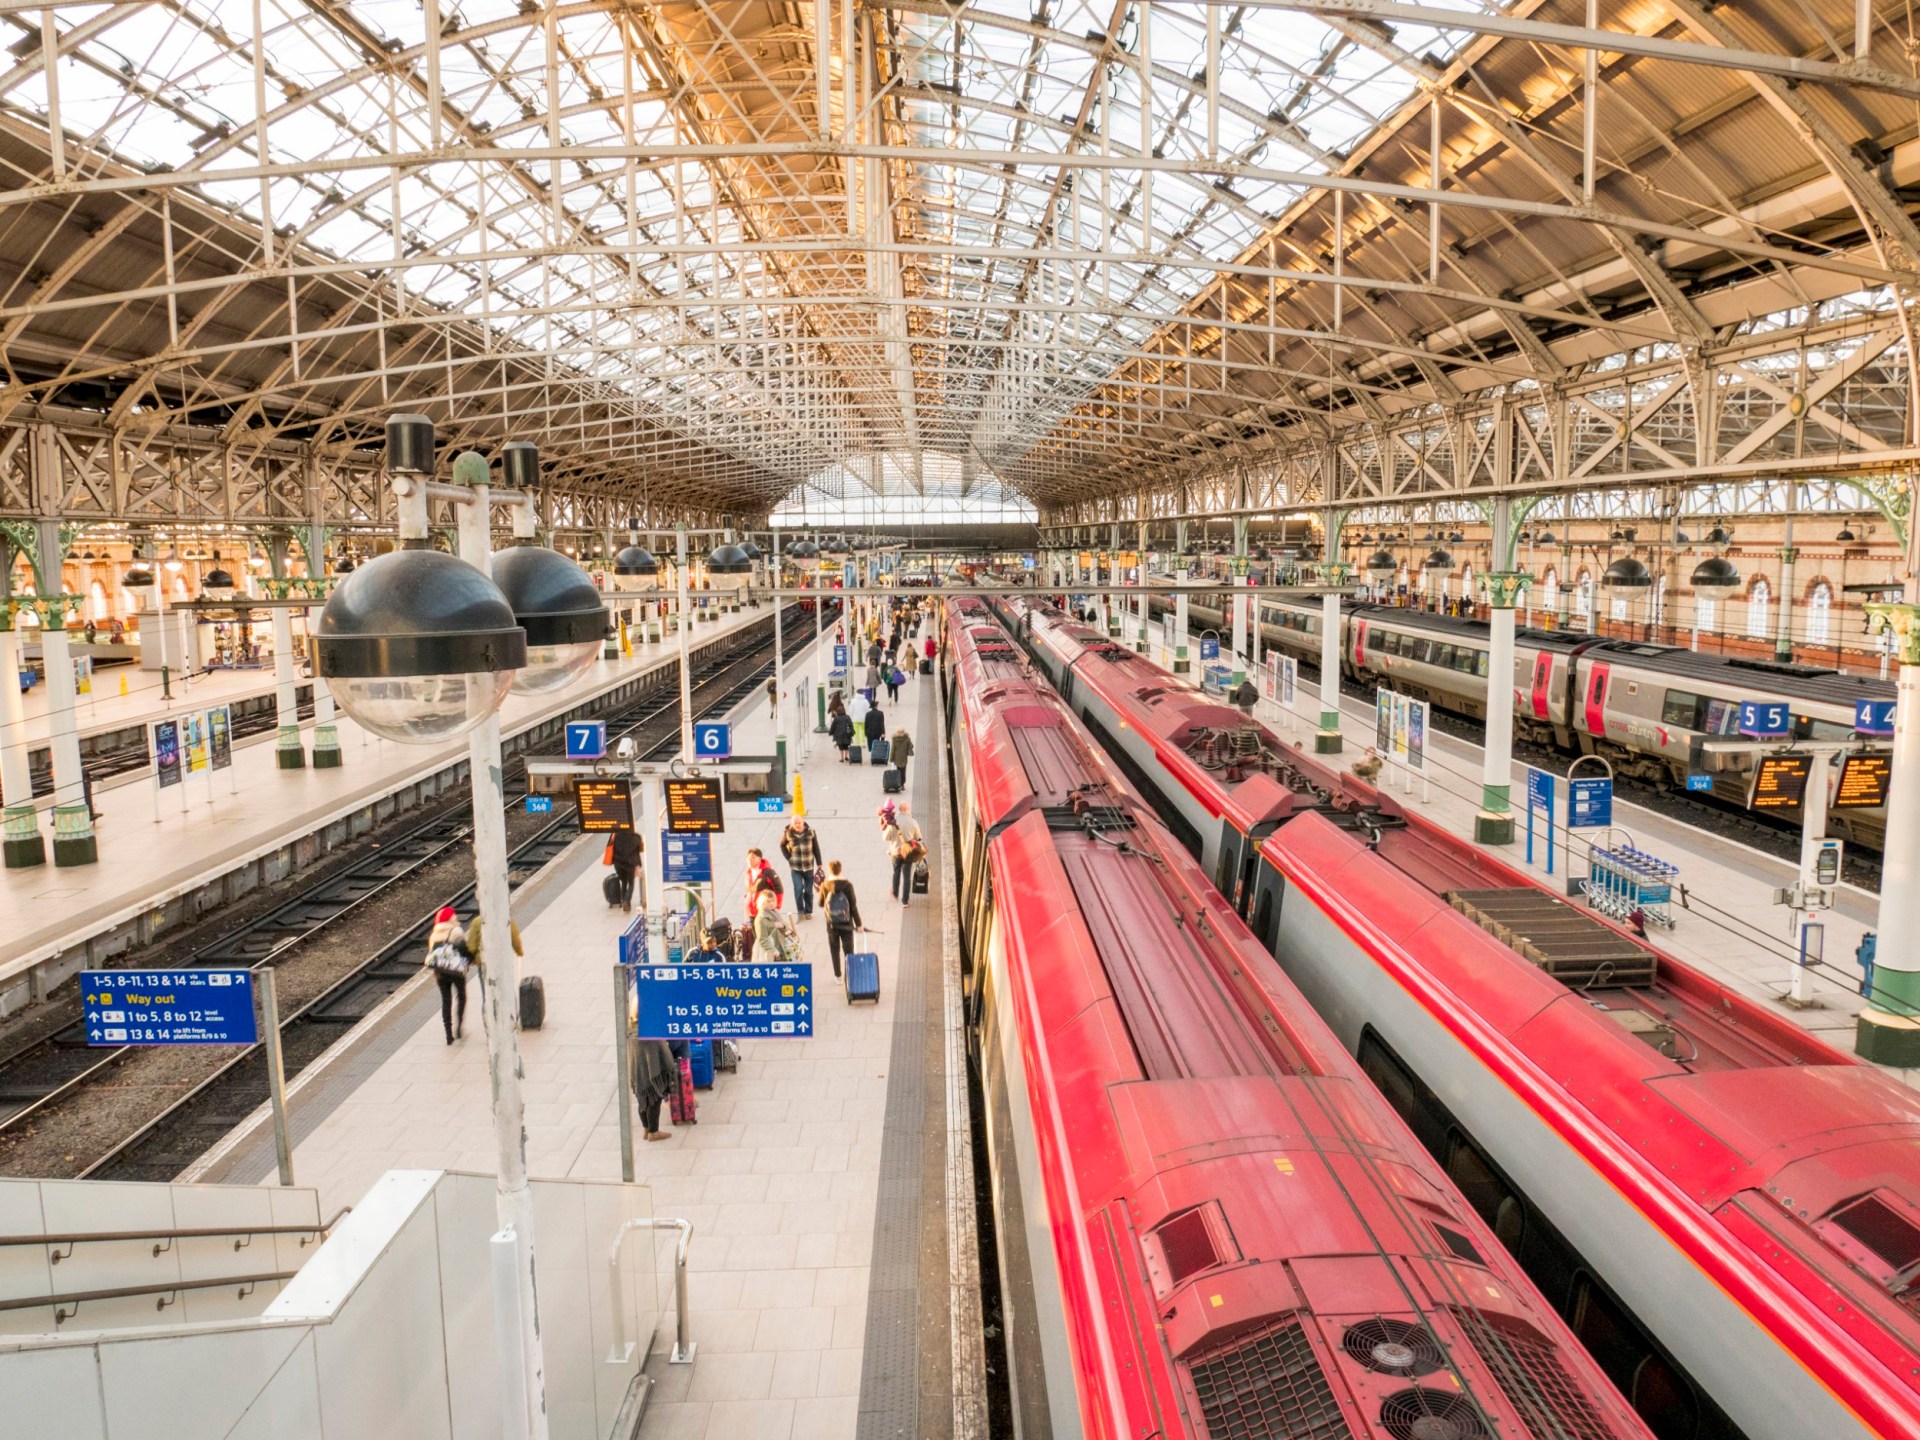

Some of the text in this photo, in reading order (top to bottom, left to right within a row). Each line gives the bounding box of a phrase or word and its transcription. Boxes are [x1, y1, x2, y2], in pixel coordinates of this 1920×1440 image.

[1745, 706, 1754, 726] 5
[1768, 708, 1781, 728] 5
[1860, 705, 1872, 724] 4
[1884, 706, 1896, 726] 4
[575, 729, 590, 750] 7
[704, 729, 720, 750] 6
[532, 803, 547, 812] 368
[764, 803, 778, 811] 366
[737, 968, 749, 979] 13
[753, 968, 762, 979] &
[765, 968, 778, 978] 14
[146, 976, 158, 986] 13
[162, 975, 171, 986] &
[174, 975, 186, 985] 14
[716, 987, 767, 999] Way out
[126, 994, 175, 1006] Way out
[668, 1005, 744, 1016] 1 to 5, 8 to 12
[128, 1011, 202, 1022] 1 to 5, 8 to 12
[130, 1029, 169, 1039] 13 & 14
[667, 1023, 708, 1034] 13 & 14
